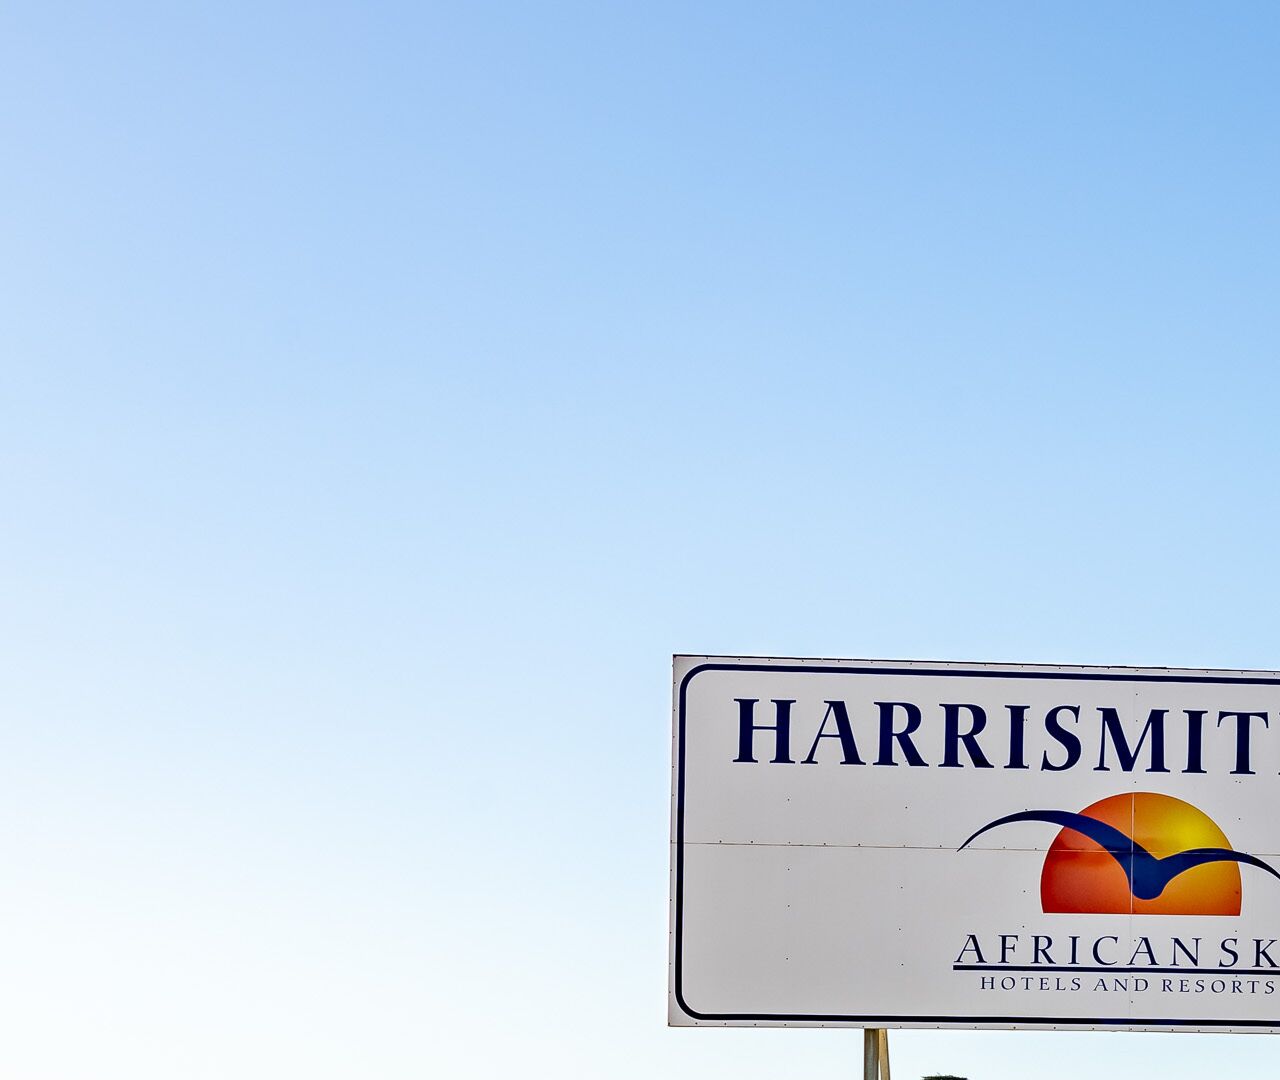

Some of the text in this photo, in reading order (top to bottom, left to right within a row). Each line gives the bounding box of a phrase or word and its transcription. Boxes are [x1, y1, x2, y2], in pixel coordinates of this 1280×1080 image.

[953, 933, 1202, 967] AFRICAN
[980, 976, 1275, 995] HOTELS AND RESORTS
